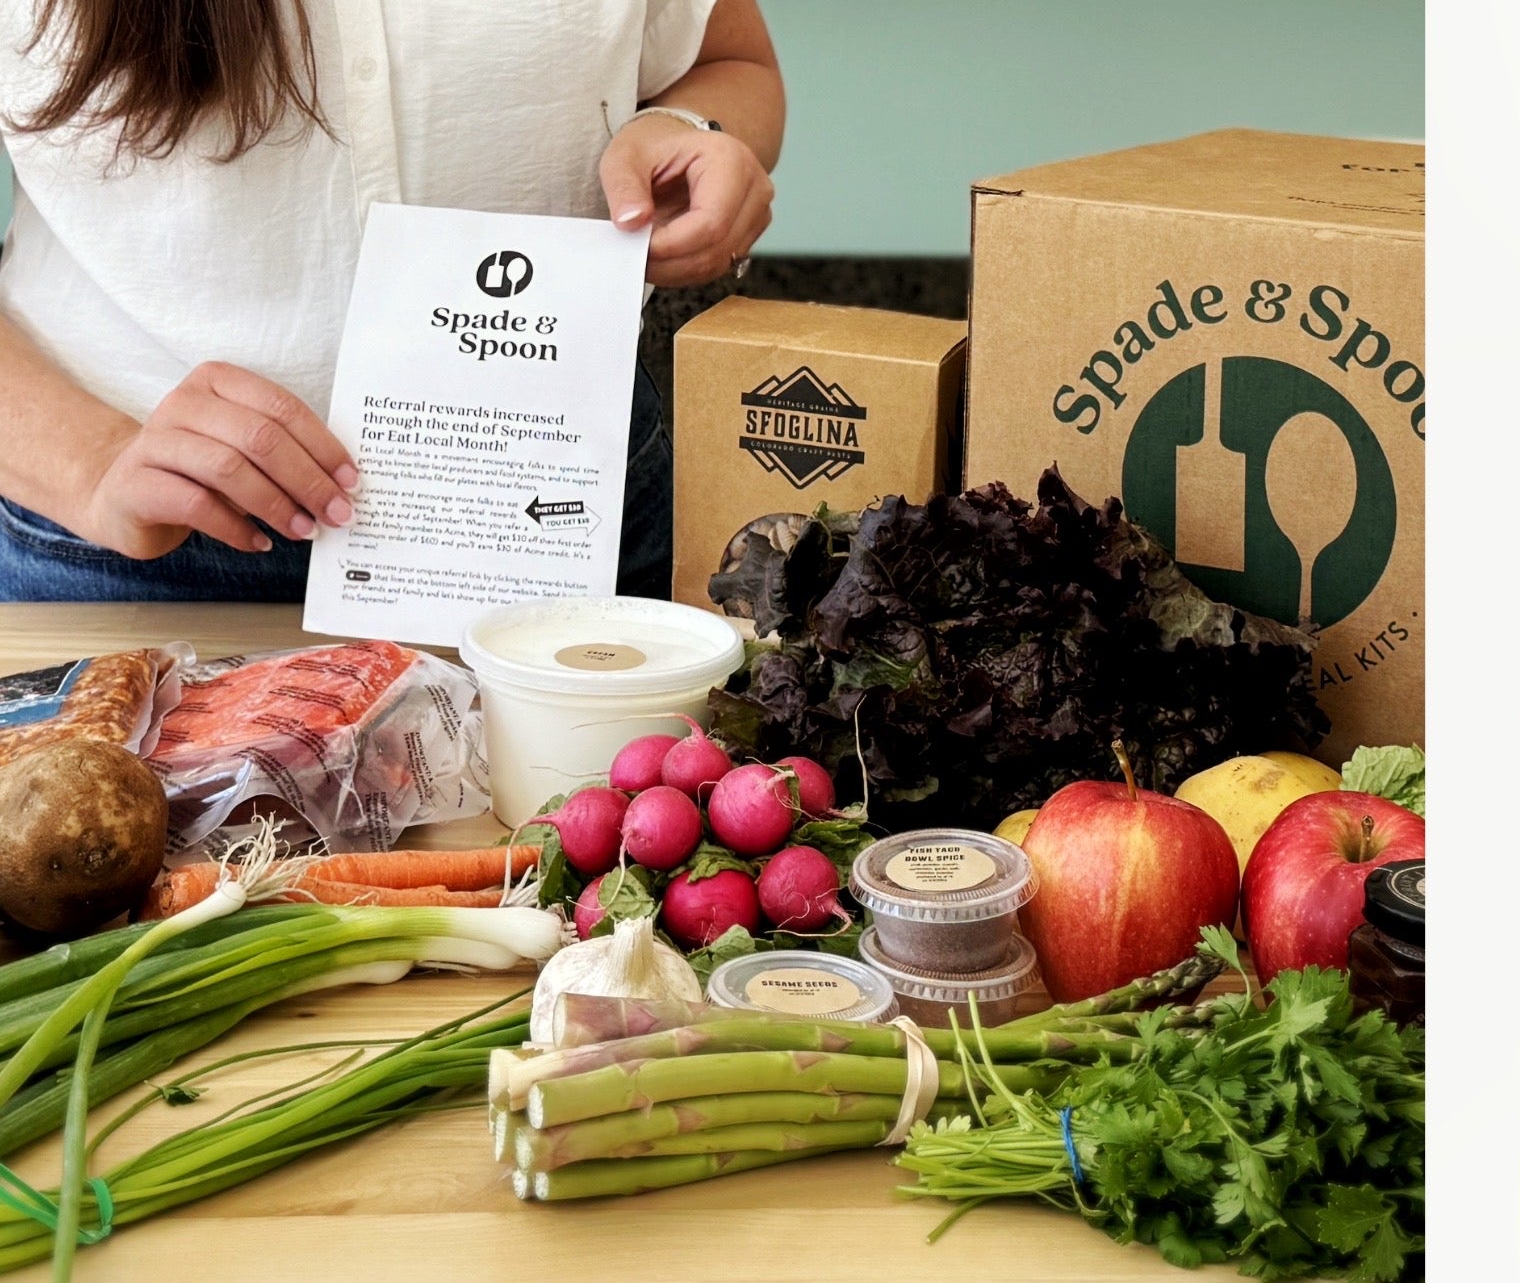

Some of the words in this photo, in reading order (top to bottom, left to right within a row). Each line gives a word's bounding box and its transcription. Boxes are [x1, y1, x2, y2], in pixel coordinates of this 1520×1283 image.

[430, 307, 528, 334] Spade
[535, 315, 559, 335] &
[458, 332, 559, 361] Spoon
[1052, 279, 1228, 435] Spade
[1245, 279, 1292, 323] &
[363, 395, 425, 411] Referral
[428, 404, 490, 418] rewards
[492, 407, 564, 425] increased
[360, 427, 385, 440] for
[387, 429, 411, 443] Eat
[414, 432, 453, 447] Local
[456, 436, 508, 452] Month!
[363, 411, 422, 429] through
[425, 417, 447, 430] the
[451, 421, 479, 433] end
[481, 422, 499, 435] of
[499, 424, 581, 442] September
[746, 409, 859, 447] SFOGLINA
[1354, 621, 1408, 671] KITS
[761, 980, 803, 988] SESAME
